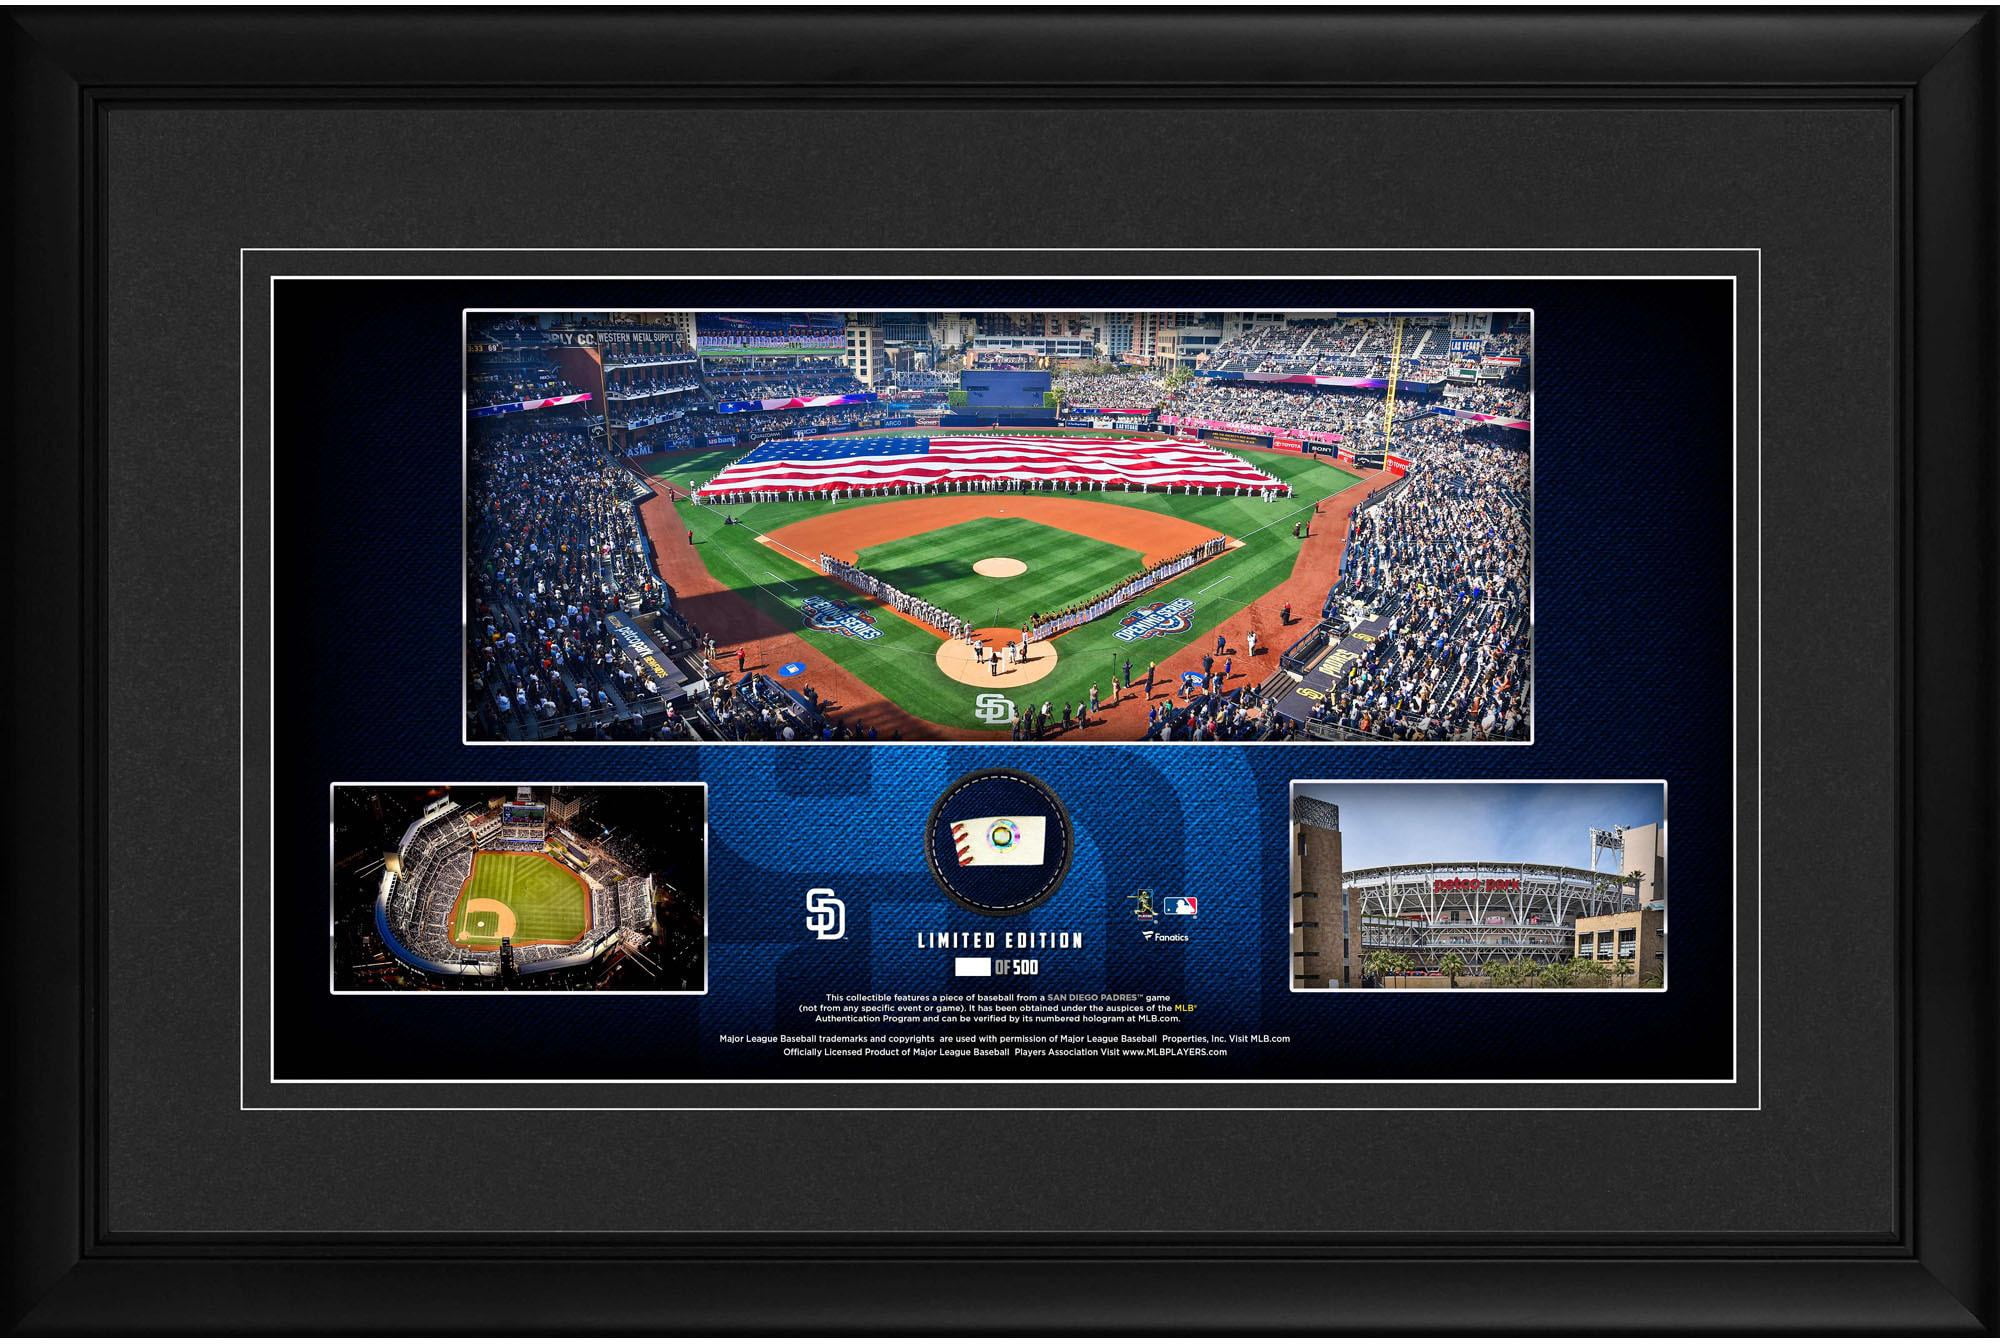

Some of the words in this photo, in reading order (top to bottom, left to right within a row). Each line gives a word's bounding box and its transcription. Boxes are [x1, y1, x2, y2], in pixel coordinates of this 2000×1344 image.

[578, 333, 598, 346] CO.
[600, 332, 630, 342] WESTERN
[632, 332, 652, 342] METAL
[653, 332, 674, 342] SUPPLY
[627, 444, 654, 457] ASML
[1115, 613, 1166, 641] OPENING
[1156, 598, 1195, 618] SERIES
[840, 617, 882, 640] SERIES
[974, 693, 1016, 725] SD
[1433, 876, 1481, 893] petco
[1485, 878, 1520, 892] park
[806, 887, 846, 940] SD
[918, 932, 994, 948] LIMITED
[1006, 932, 1081, 948] EDITION
[1154, 932, 1190, 942] Fanatics
[996, 960, 1010, 974] OF
[1013, 960, 1038, 975] 500
[825, 993, 844, 1002] This
[845, 993, 892, 1002] collectible
[893, 993, 930, 1002] features
[939, 993, 964, 1003] piece
[965, 993, 976, 1002] of
[977, 993, 1014, 1002] baseball
[1016, 993, 1038, 1002] from
[1047, 993, 1067, 1001] SAN
[1069, 993, 1099, 1001] DIEGO
[1145, 995, 1171, 1003] game
[798, 1004, 818, 1013] (not
[819, 1004, 841, 1012] from
[842, 1005, 859, 1013] any
[861, 1003, 895, 1013] specific
[897, 1004, 922, 1012] event
[935, 1004, 967, 1013] game).
[969, 1004, 976, 1012] It
[977, 1004, 993, 1012] has
[995, 1004, 1017, 1012] been
[1019, 1004, 1059, 1012] obtained
[1061, 1004, 1087, 1012] under
[1089, 1004, 1104, 1012] the
[1105, 1004, 1144, 1013] auspices
[1145, 1004, 1156, 1012] of
[1157, 1004, 1173, 1012] the
[815, 1014, 881, 1023] Authentication
[882, 1014, 921, 1024] Program
[922, 1014, 940, 1023] and
[959, 1014, 971, 1023] be
[973, 1014, 1007, 1023] verified
[1009, 1014, 1020, 1024] by
[1022, 1014, 1034, 1023] its
[1035, 1014, 1081, 1023] numbered
[1082, 1014, 1125, 1024] hologram
[1126, 1015, 1136, 1023] at
[1138, 1014, 1181, 1023] MLB.com.
[719, 1034, 745, 1044] Major
[746, 1034, 778, 1044] League
[780, 1034, 817, 1043] Baseball
[818, 1034, 868, 1043] trademarks
[869, 1034, 887, 1043] and
[888, 1034, 935, 1044] copyrights
[955, 1034, 977, 1043] used
[978, 1034, 998, 1043] with
[999, 1034, 1047, 1044] permission
[1048, 1034, 1059, 1043] of
[1060, 1034, 1085, 1044] Major
[1086, 1034, 1119, 1044] League
[1120, 1034, 1157, 1043] Baseball
[1162, 1034, 1209, 1044] Properties,
[1211, 1034, 1227, 1043] Inc.
[1228, 1034, 1249, 1043] Visit
[1250, 1034, 1291, 1043] MLB.com
[783, 1047, 823, 1057] Officially
[824, 1047, 863, 1056] Licensed
[864, 1047, 900, 1056] Product
[901, 1047, 911, 1056] of
[913, 1047, 938, 1057] Major
[939, 1047, 971, 1058] League
[973, 1047, 1010, 1056] Baseball
[1014, 1047, 1047, 1057] Players
[1047, 1047, 1099, 1056] Association
[1100, 1047, 1120, 1056] Visit
[1122, 1047, 1228, 1056] www.MLBPLAYERS.com
